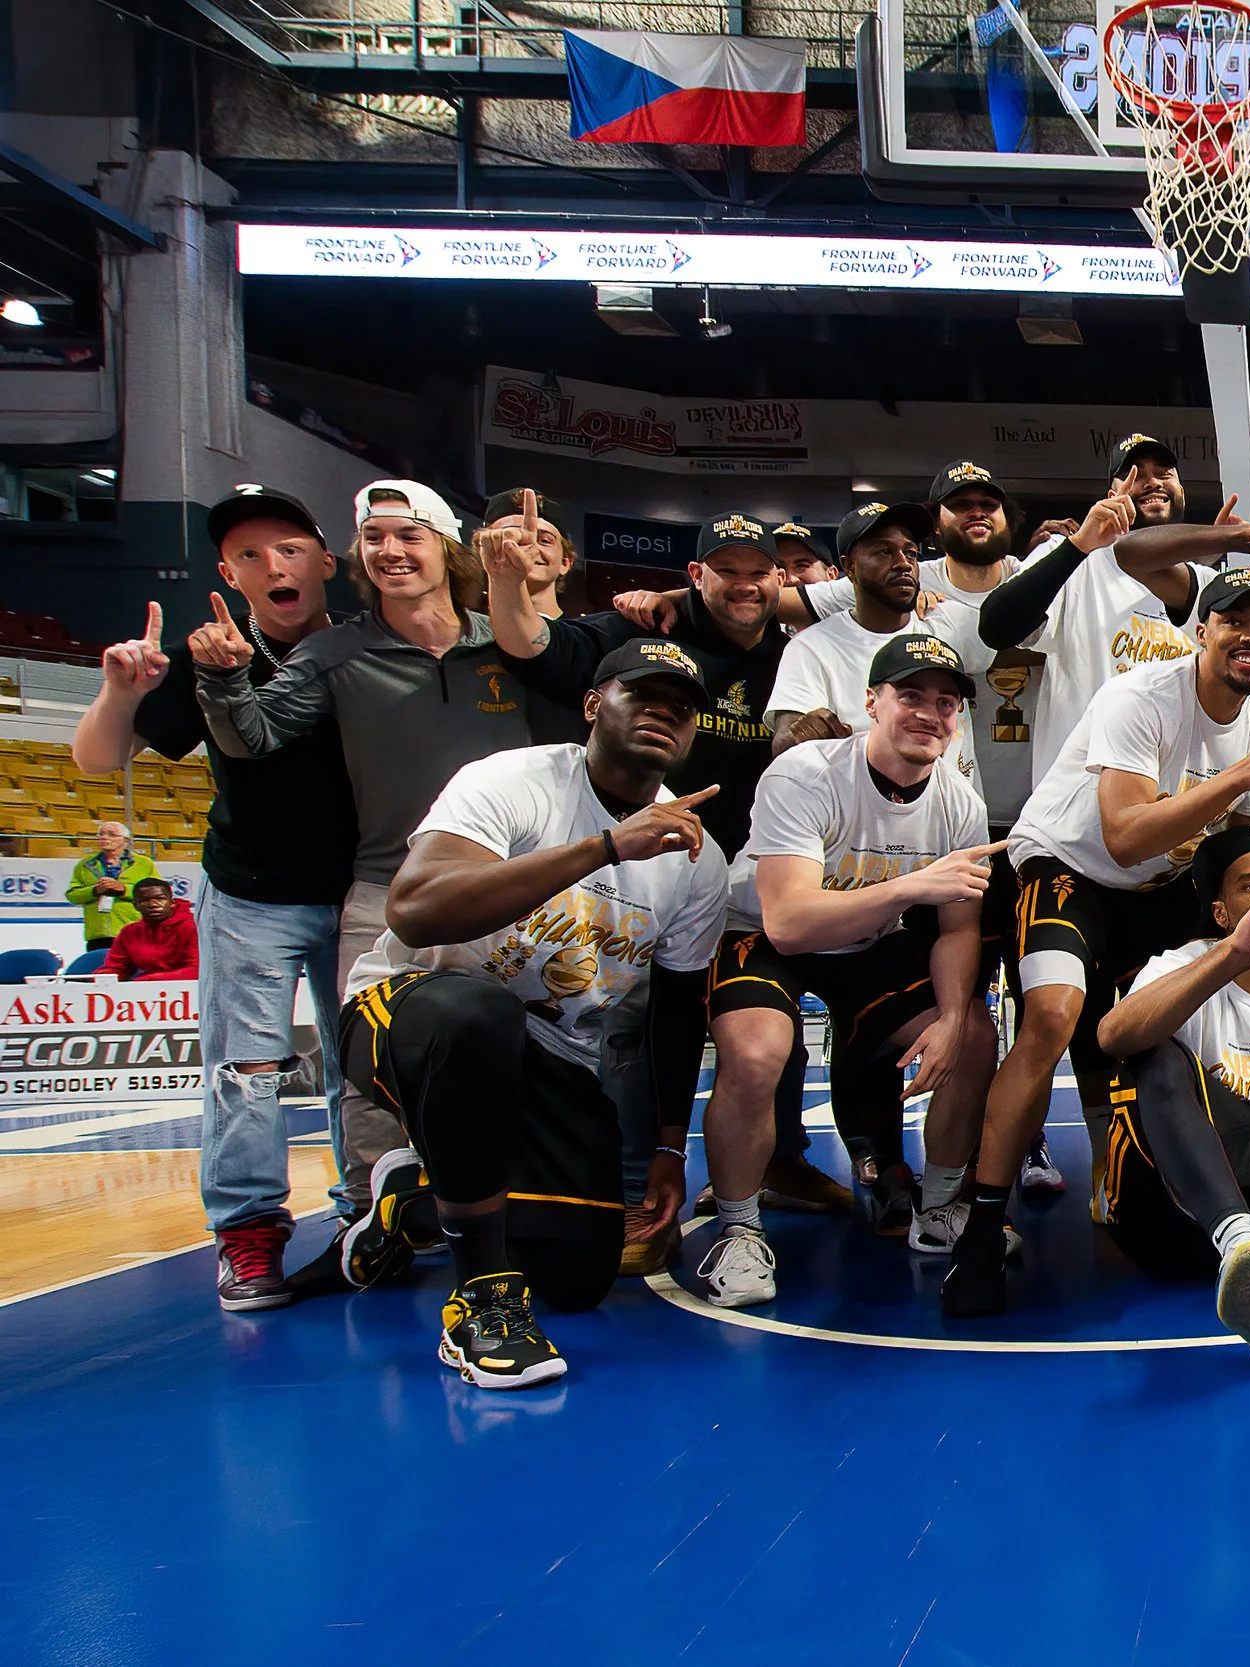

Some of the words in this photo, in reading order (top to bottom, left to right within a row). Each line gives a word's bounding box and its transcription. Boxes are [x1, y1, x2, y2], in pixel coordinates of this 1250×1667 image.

[306, 238, 386, 250] FRONTLINE
[443, 241, 522, 253] FRONTLINE
[578, 243, 657, 255] FRONTLINE
[314, 251, 396, 263] FORWARD
[452, 254, 532, 266] FORWARD
[822, 249, 899, 261] FRONTLINE
[952, 253, 1028, 265] FRONTLINE
[586, 256, 667, 269] FORWARD
[829, 262, 908, 275] FORWARD
[1082, 257, 1156, 269] FRONTLINE
[961, 265, 1038, 278] FORWARD
[1089, 269, 1165, 283] FORWARD
[556, 394, 676, 453] Louis
[602, 530, 672, 554] pepsi
[1111, 631, 1193, 663] CHAMPI
[695, 711, 771, 738] IGHTNIN
[885, 844, 905, 852] 2022
[2, 876, 48, 896] er's
[593, 881, 617, 896] 2022
[515, 905, 655, 968] CHAMPIONS
[1, 994, 74, 1026] Ask
[84, 990, 200, 1023] David.
[0, 1031, 200, 1068] EGOTIAT
[13, 1076, 118, 1094] SCHOOLEY
[128, 1073, 205, 1092] 519.577.
